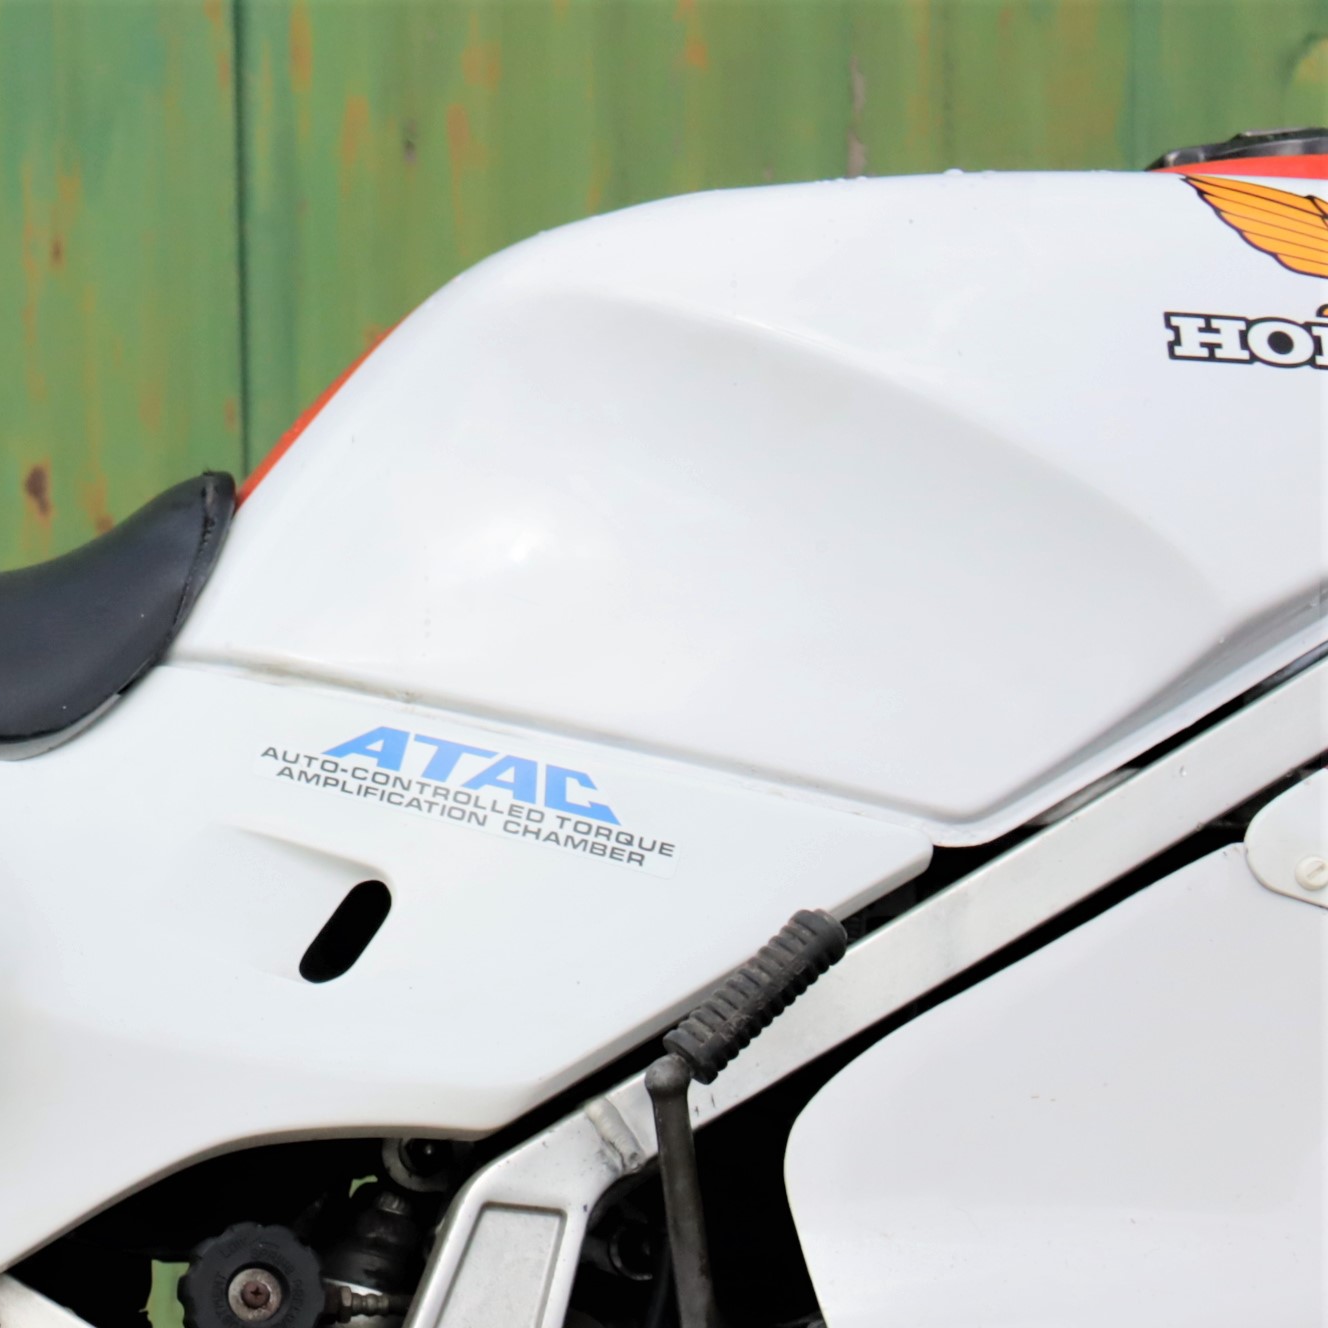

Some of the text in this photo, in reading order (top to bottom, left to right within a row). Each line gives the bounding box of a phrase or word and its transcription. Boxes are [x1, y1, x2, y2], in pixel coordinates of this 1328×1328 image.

[260, 746, 676, 858] AUTO-CONTROLLED TORQUE
[275, 766, 646, 867] AMPLIFICATION CHAMBER
[321, 725, 622, 826] ATAC
